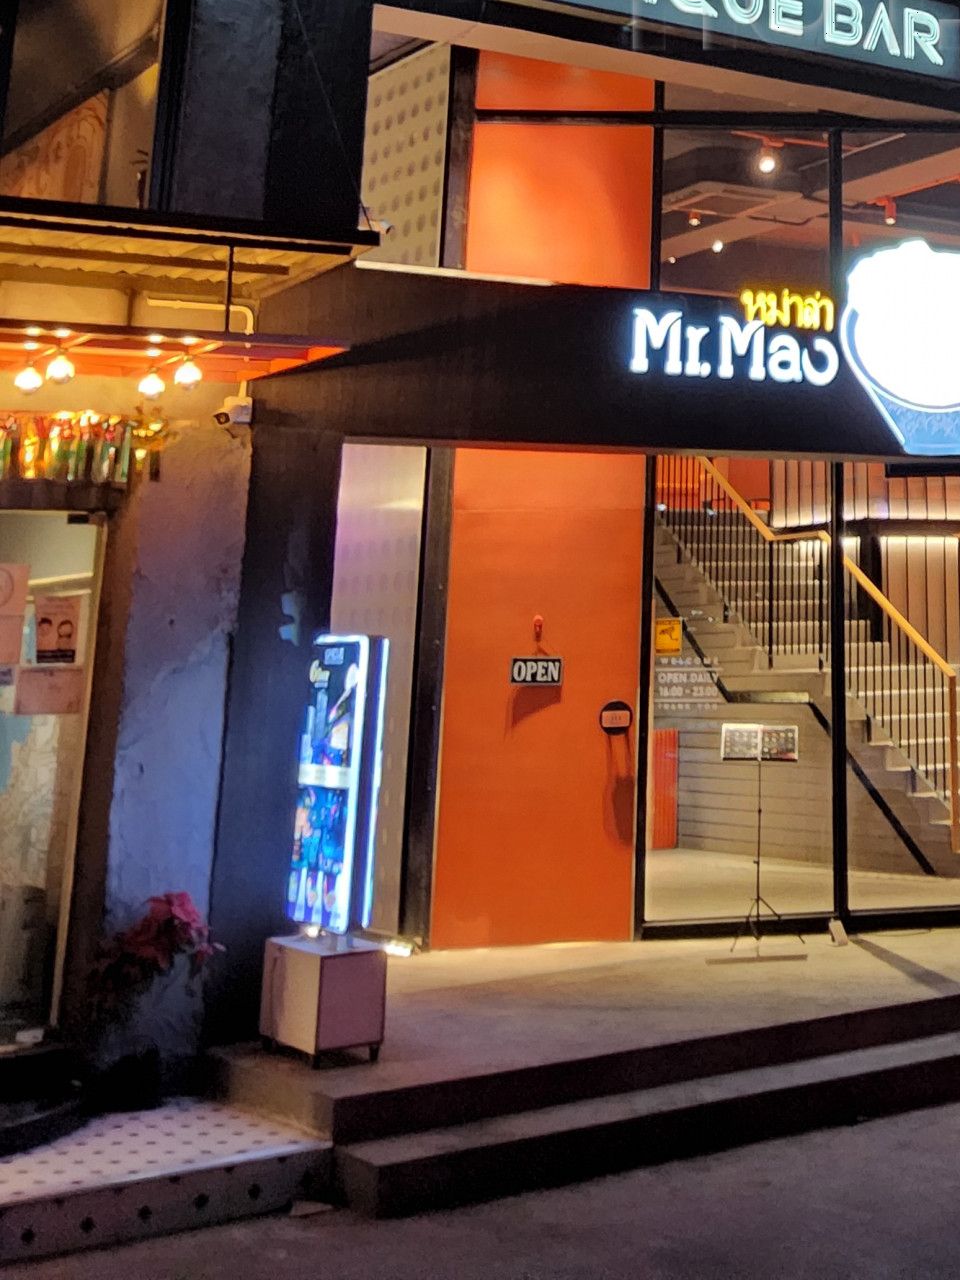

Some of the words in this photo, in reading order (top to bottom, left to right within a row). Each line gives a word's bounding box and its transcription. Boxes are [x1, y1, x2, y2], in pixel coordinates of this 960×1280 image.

[740, 288, 835, 332] หม่าล่า
[512, 660, 560, 682] OPEN
[657, 672, 688, 683] OPEN
